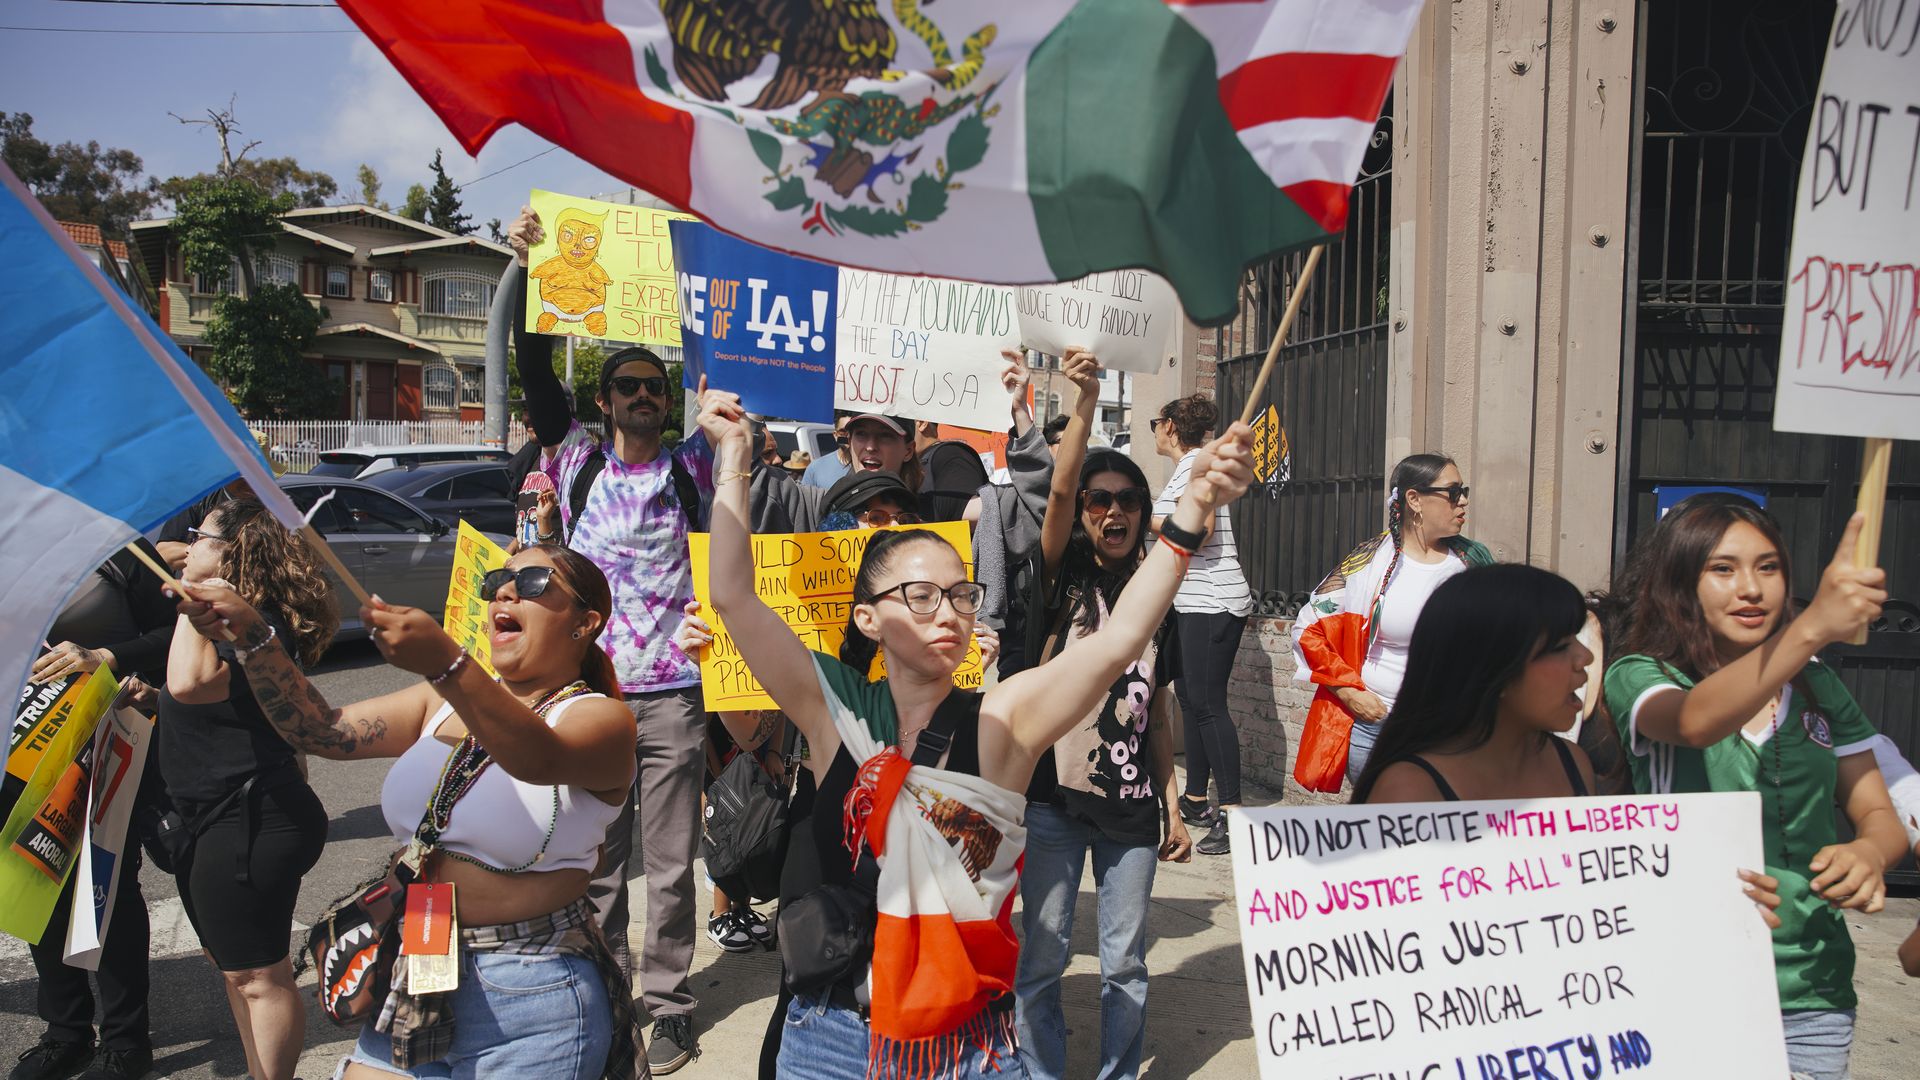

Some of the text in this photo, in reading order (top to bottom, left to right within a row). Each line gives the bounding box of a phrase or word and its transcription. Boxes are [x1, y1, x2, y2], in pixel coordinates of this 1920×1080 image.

[1812, 93, 1891, 211] BUT
[710, 278, 740, 310] OUT
[874, 273, 905, 326] THE
[903, 278, 1013, 337] MOUNTAINS
[1111, 270, 1149, 300] NOT
[711, 310, 733, 340] OF
[1060, 296, 1092, 330] YOU
[1099, 304, 1152, 338] KINDLY
[851, 324, 878, 355] THE
[715, 351, 739, 361] Deport
[749, 355, 768, 365] Migra
[769, 358, 785, 367] NOT
[787, 361, 799, 369] the
[800, 362, 826, 373] People
[912, 369, 979, 410] USA
[28, 831, 68, 870] AHORA!
[1249, 823, 1258, 865] I
[1263, 818, 1310, 862] DID
[1315, 817, 1371, 857] NOT
[1377, 810, 1482, 849] RECITE
[1565, 803, 1680, 832] LIBERTY
[1249, 888, 1308, 926] AND
[1316, 875, 1423, 915] JUSTICE
[1579, 843, 1670, 884] EVERY
[1255, 905, 1635, 996] MORNING JUST TO BE
[1268, 998, 1396, 1057] CALLED
[1414, 979, 1543, 1033] RADICAL
[1607, 1029, 1652, 1075] AND
